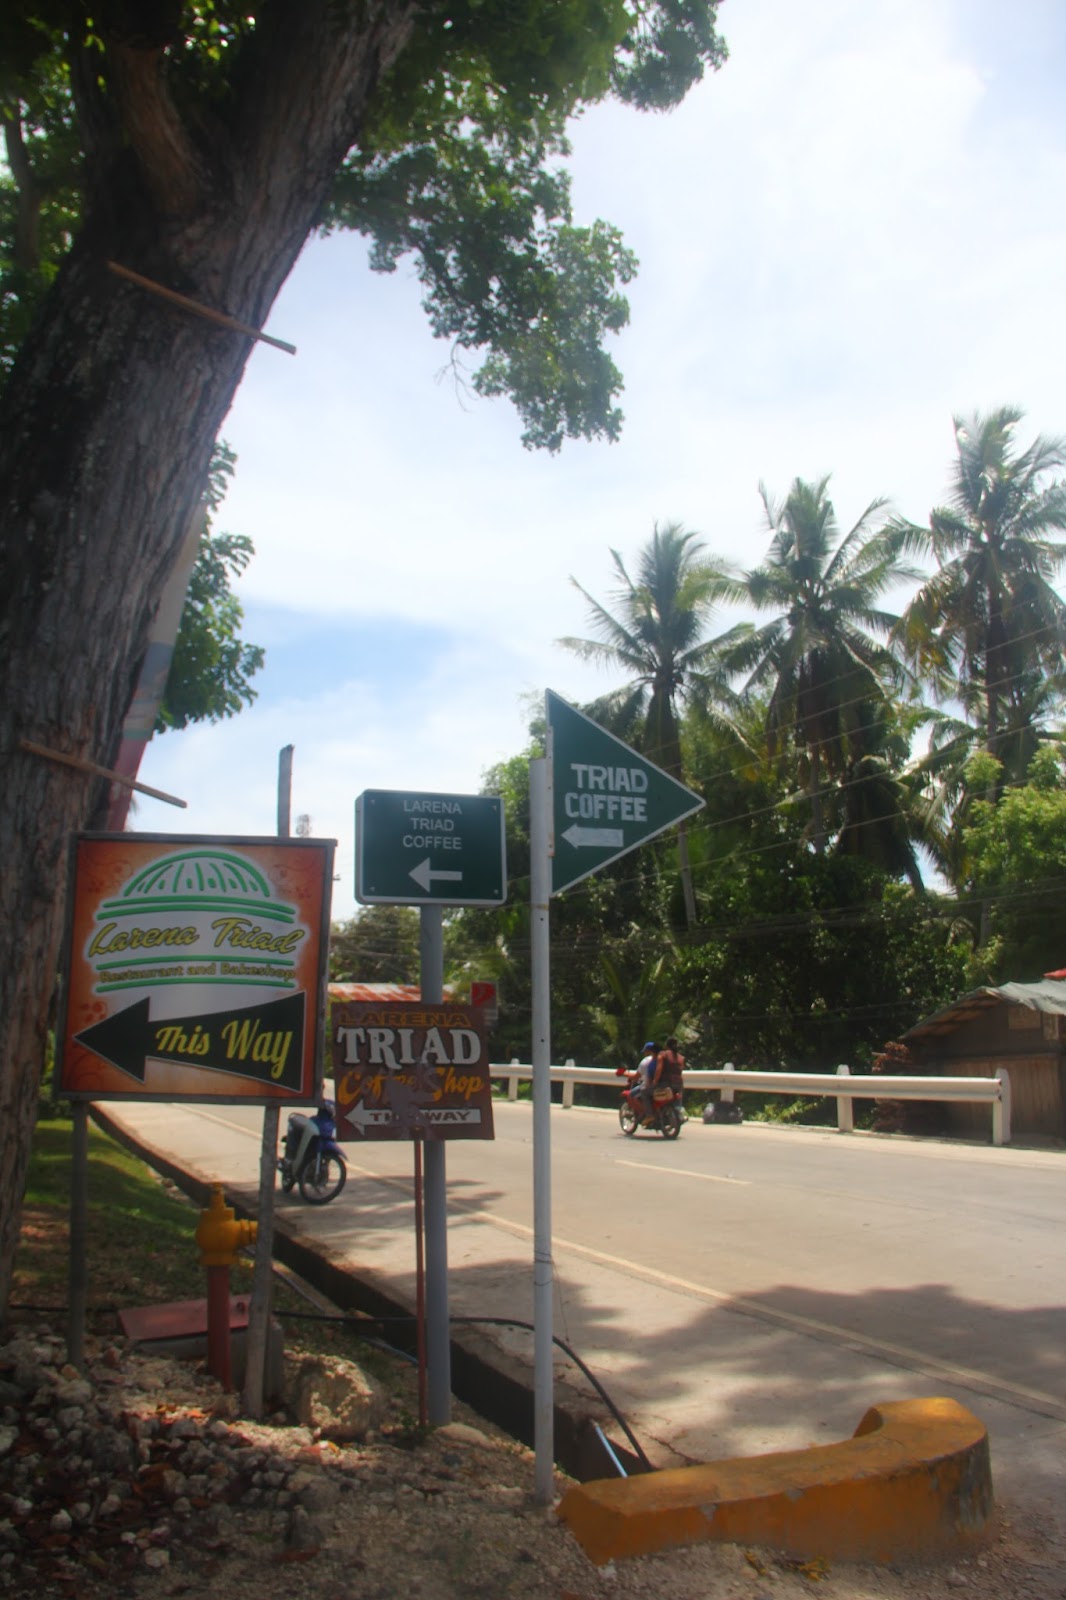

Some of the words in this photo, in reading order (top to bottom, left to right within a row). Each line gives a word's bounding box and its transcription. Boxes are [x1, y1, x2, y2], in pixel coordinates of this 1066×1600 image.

[571, 763, 648, 793] TRIAD
[403, 800, 462, 815] LARENA
[565, 792, 647, 822] COFFEE
[410, 817, 454, 832] TRIAD
[402, 835, 462, 850] COFFEE
[88, 922, 200, 957] Larena
[211, 917, 305, 955] Triad
[100, 965, 184, 983] Restaurant
[187, 963, 216, 976] and
[220, 963, 296, 982] Bakeshop
[338, 1011, 472, 1027] LARENA
[155, 1025, 211, 1056] This
[221, 1018, 293, 1079] Way
[336, 1026, 482, 1070] TRIAD
[426, 1111, 471, 1121] WAY
